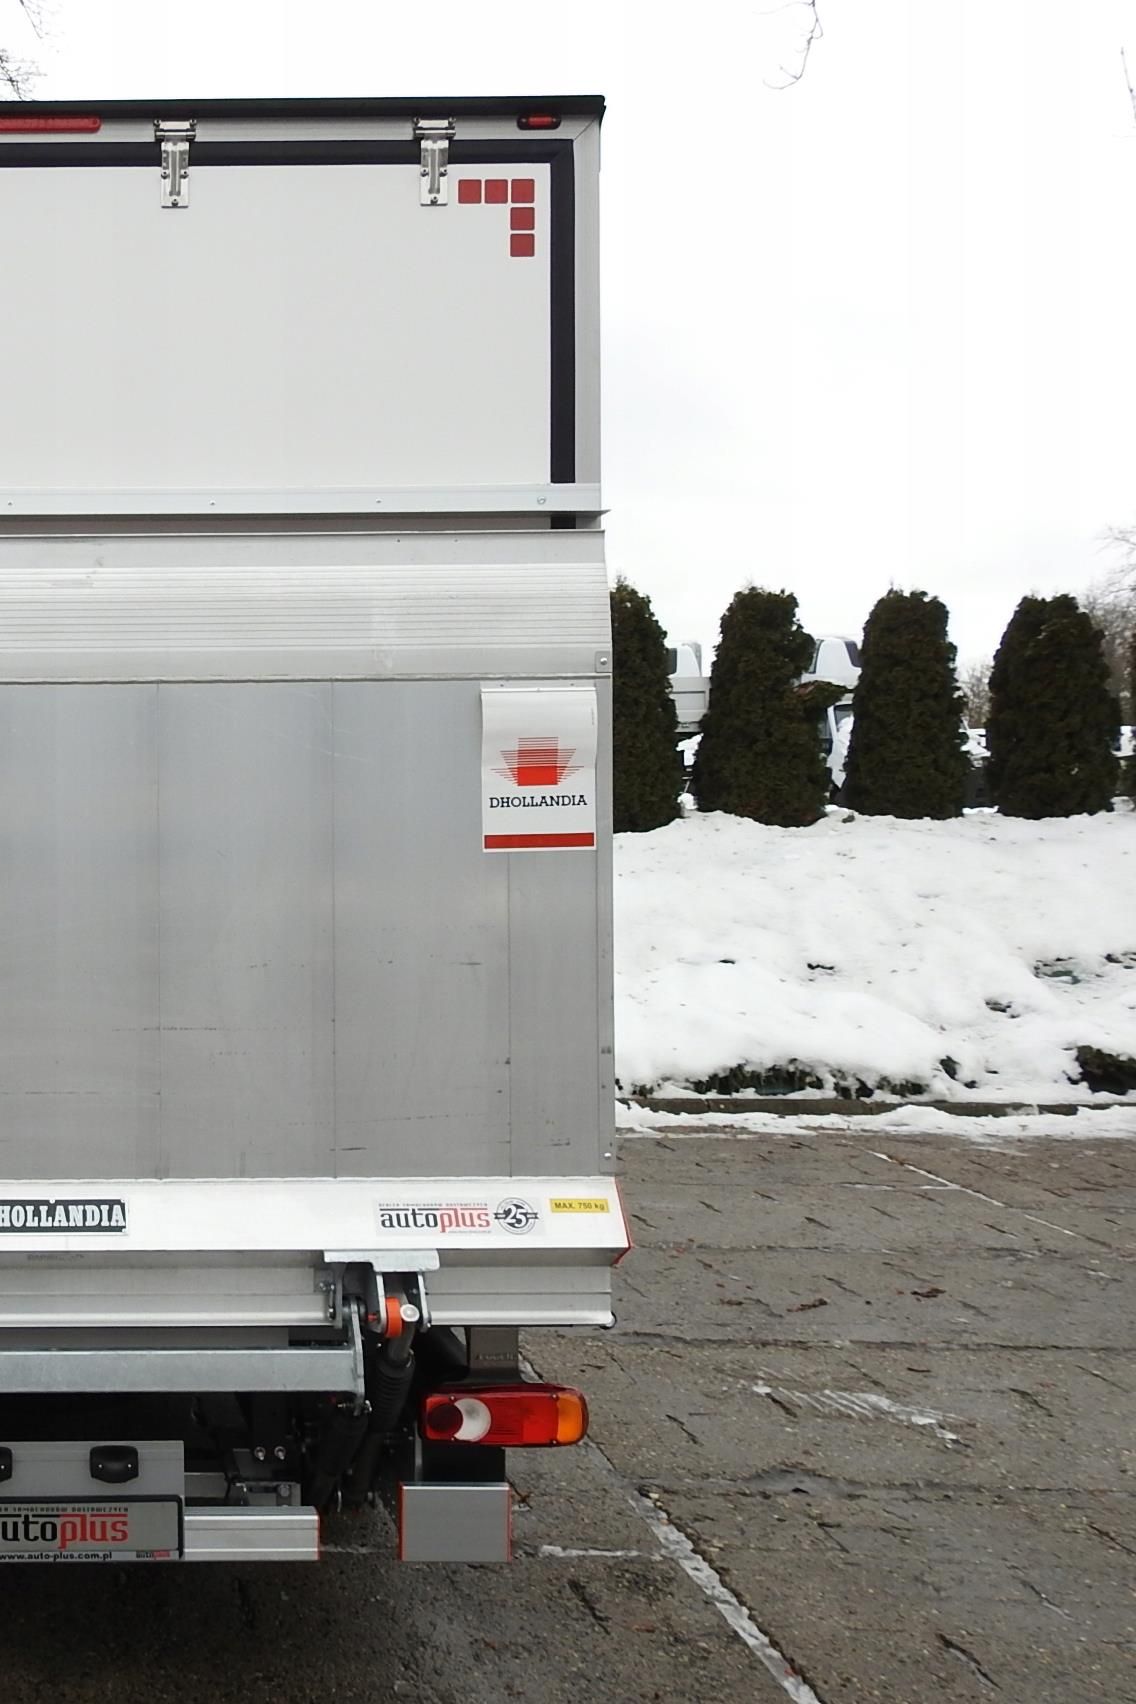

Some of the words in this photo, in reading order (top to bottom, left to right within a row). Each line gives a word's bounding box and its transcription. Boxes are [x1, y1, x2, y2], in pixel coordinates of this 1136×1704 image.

[489, 795, 587, 808] DHOLLANDIA
[595, 1202, 605, 1210] kg
[380, 1208, 491, 1233] autoplus
[503, 1204, 528, 1228] 25
